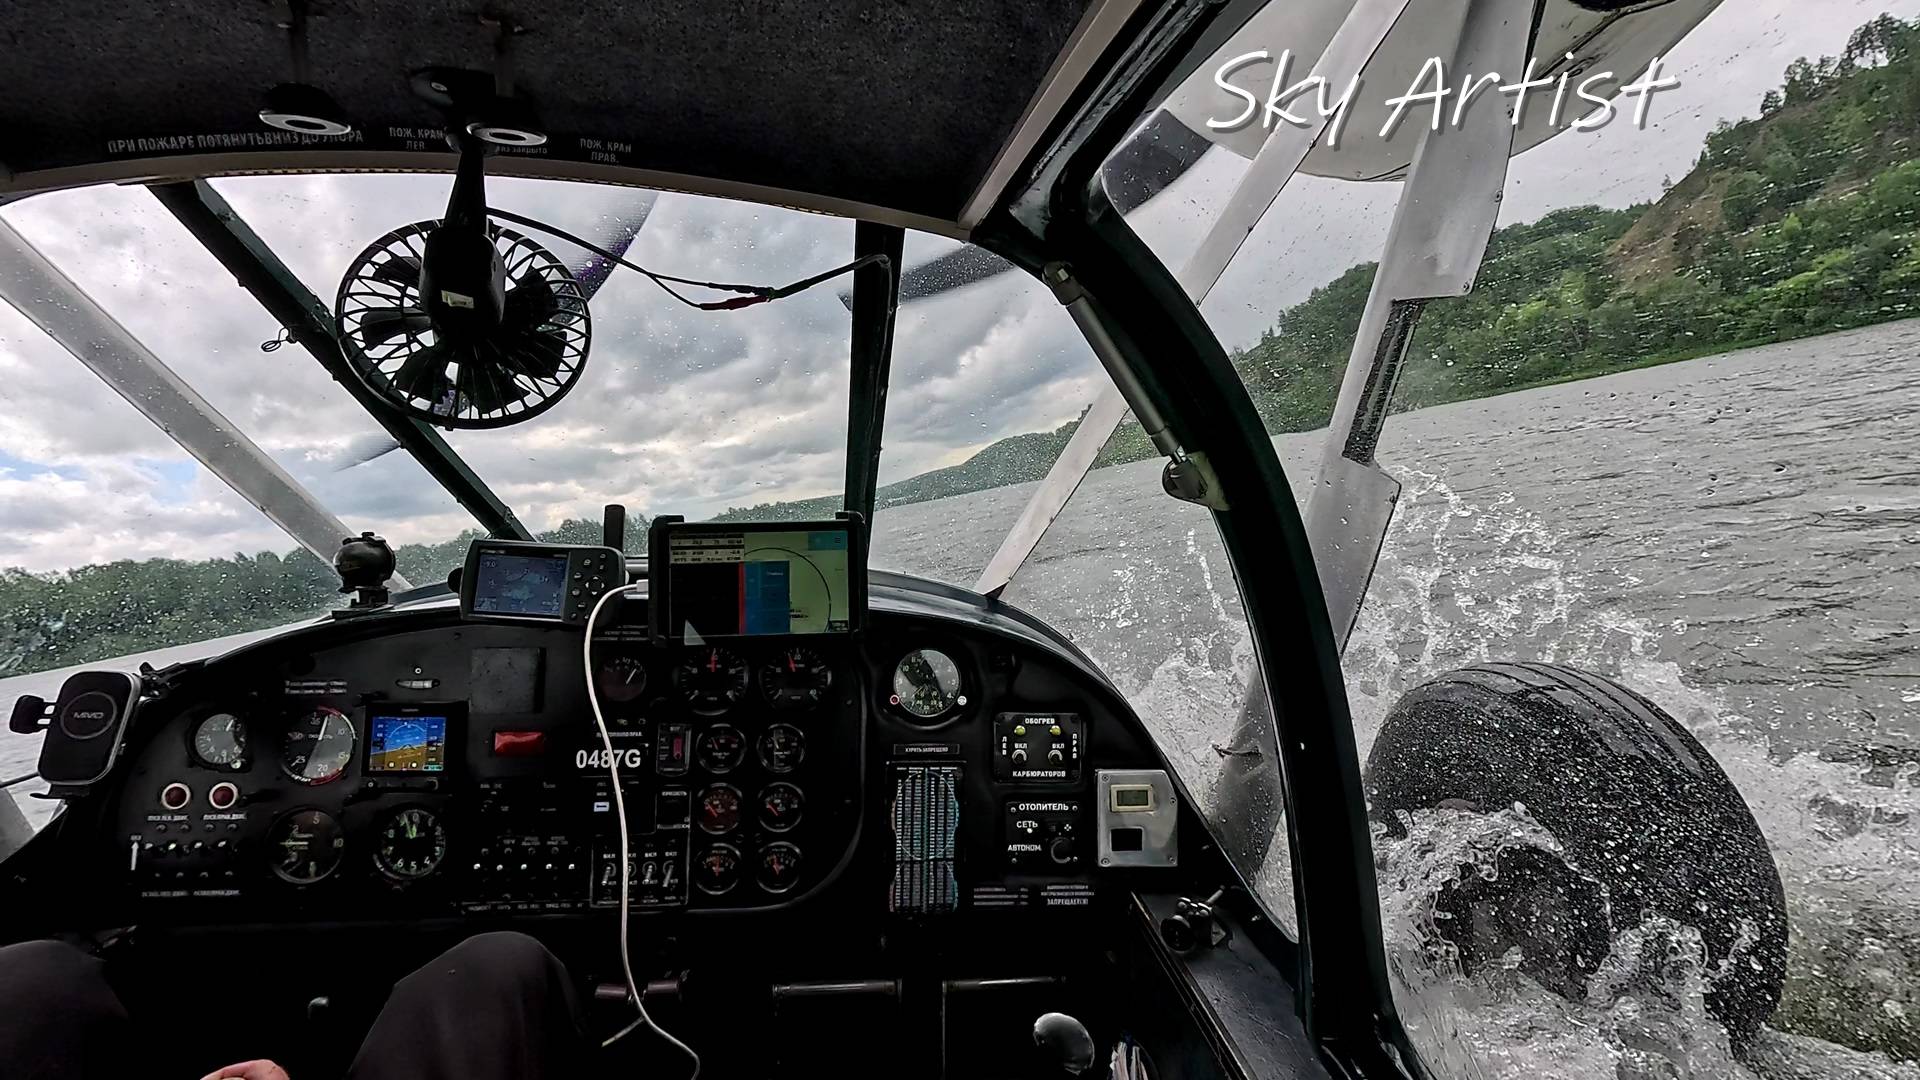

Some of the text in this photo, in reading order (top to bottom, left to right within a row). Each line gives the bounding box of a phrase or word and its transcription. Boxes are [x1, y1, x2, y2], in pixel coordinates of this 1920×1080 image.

[388, 127, 445, 140] ПОЖ. КРАН
[107, 139, 136, 153] ПРИ
[137, 135, 195, 152] ПОЖАРЕ
[301, 133, 318, 146] ДО
[579, 137, 632, 153] ПОЖ. КРАН
[1024, 717, 1056, 725] ОБОГРЕВ
[575, 748, 642, 769] 0487G
[1018, 803, 1070, 812] ОТОПИТЕЛЬ
[1016, 820, 1039, 829] СЕТЬ
